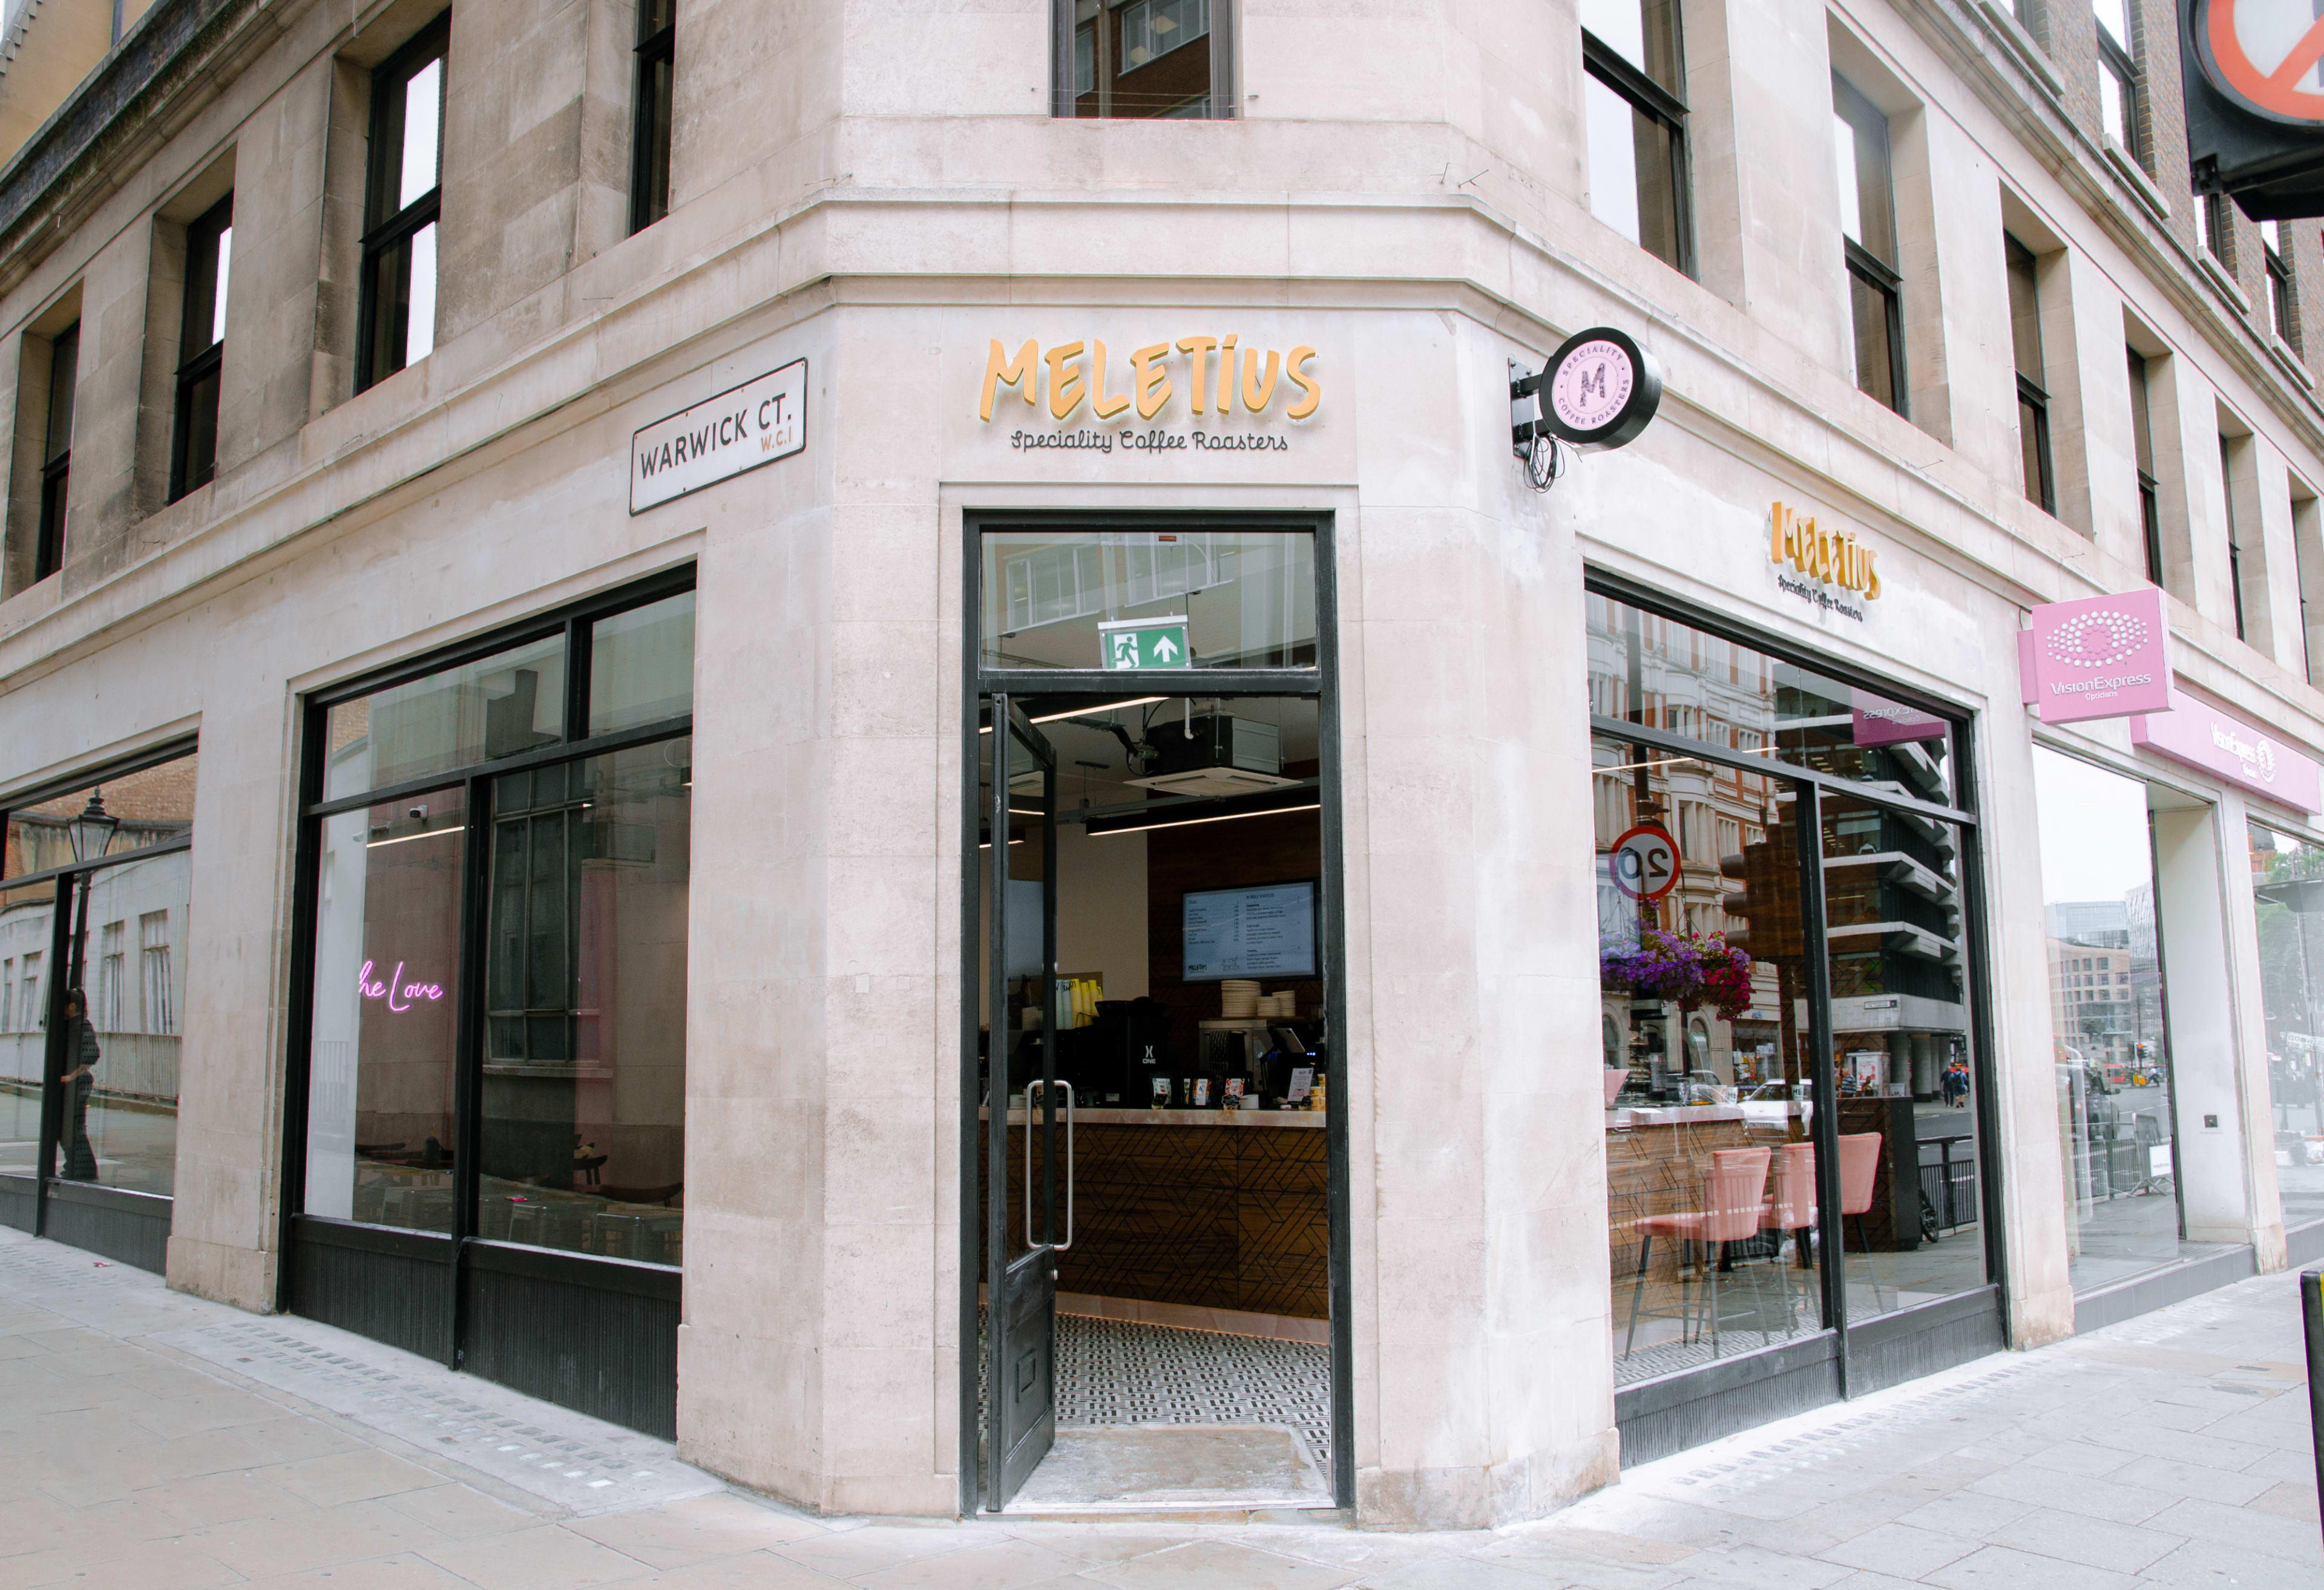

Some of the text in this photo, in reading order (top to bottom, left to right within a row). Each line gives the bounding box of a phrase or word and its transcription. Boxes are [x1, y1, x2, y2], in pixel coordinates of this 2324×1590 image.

[1563, 345, 1623, 376] SPECIALITY
[1558, 379, 1629, 425] COFFEE ROASTERS
[1580, 362, 1605, 407] M
[640, 392, 792, 480] WARWICK CT.
[1011, 430, 1288, 454] Speciality Coffee Roasters
[1777, 574, 1863, 623] Speciality Coffee Roasters
[2049, 673, 2152, 695] VisionExpress
[2085, 690, 2118, 701] Opticians
[389, 961, 444, 1012] Love
